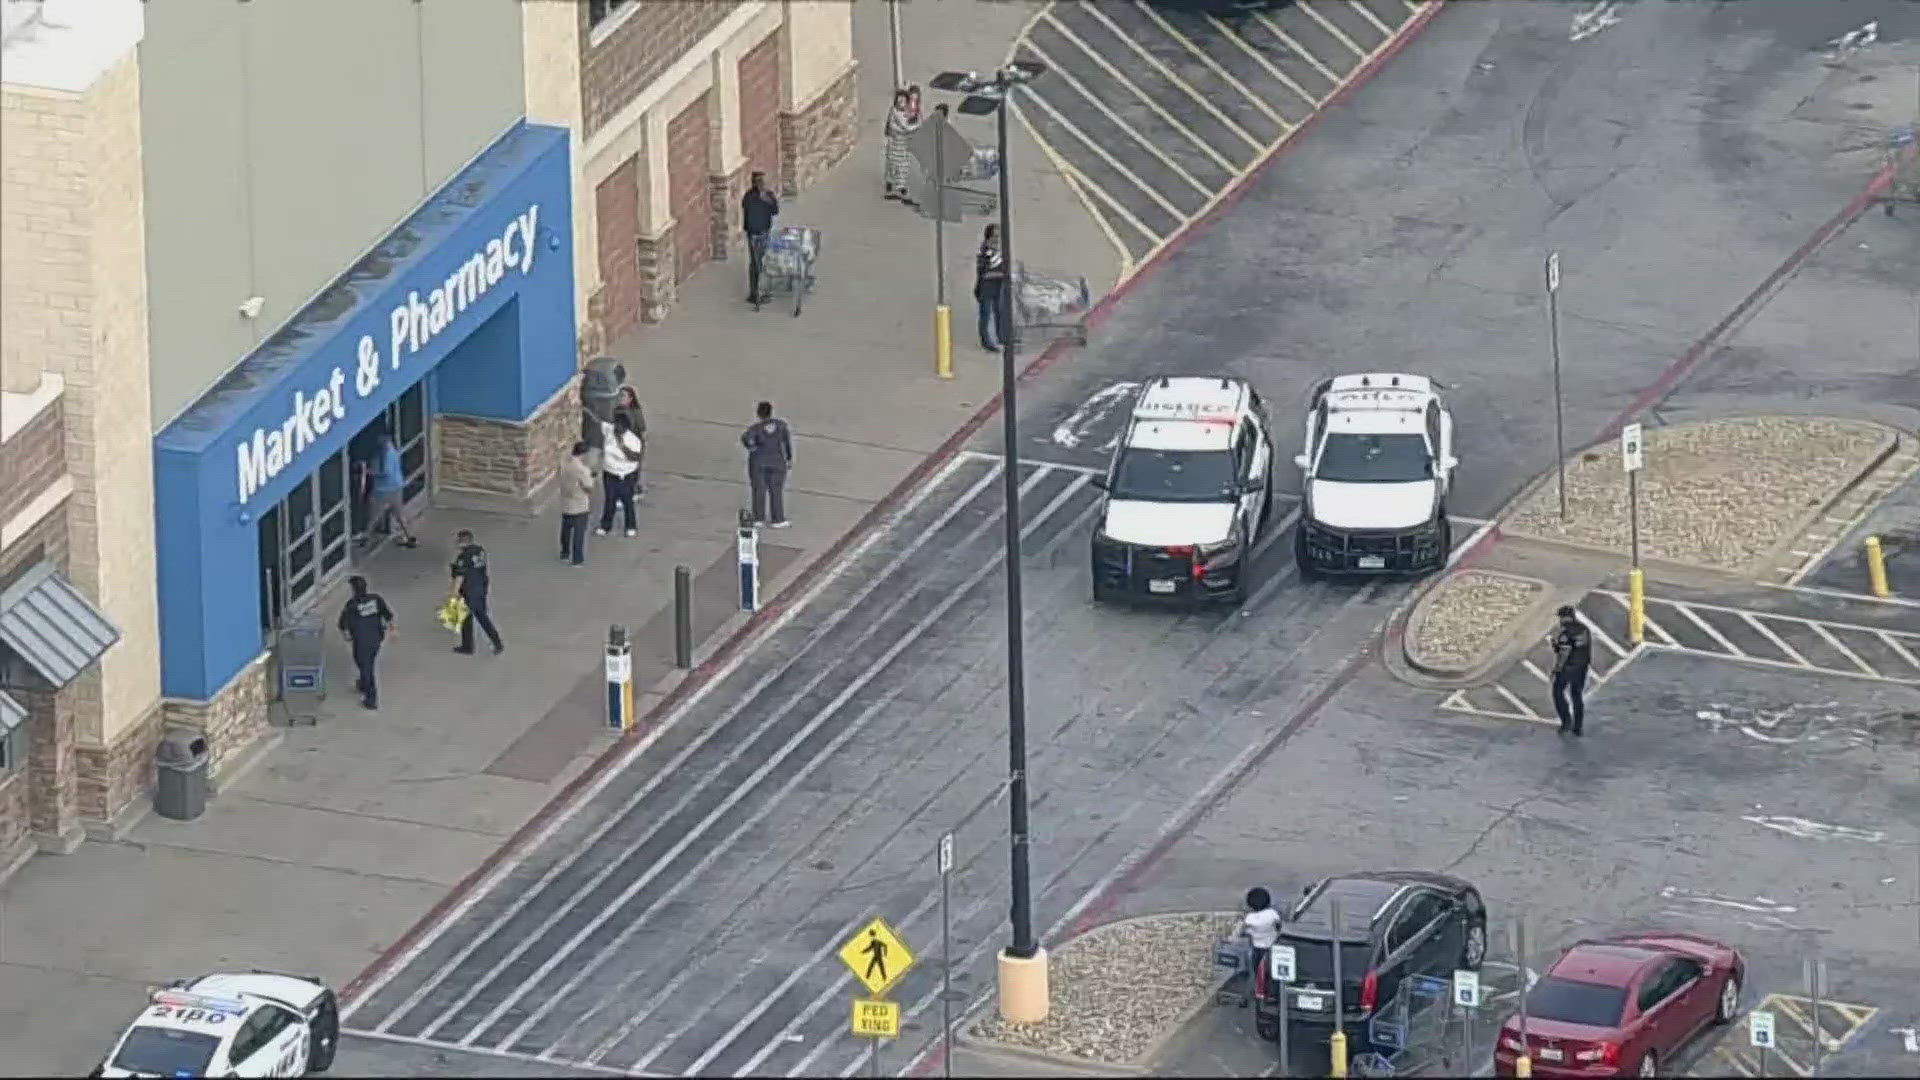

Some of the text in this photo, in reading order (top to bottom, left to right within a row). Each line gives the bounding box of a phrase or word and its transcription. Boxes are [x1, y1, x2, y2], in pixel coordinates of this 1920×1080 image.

[236, 204, 540, 505] Market & Pharmacy
[863, 1004, 889, 1017] PED
